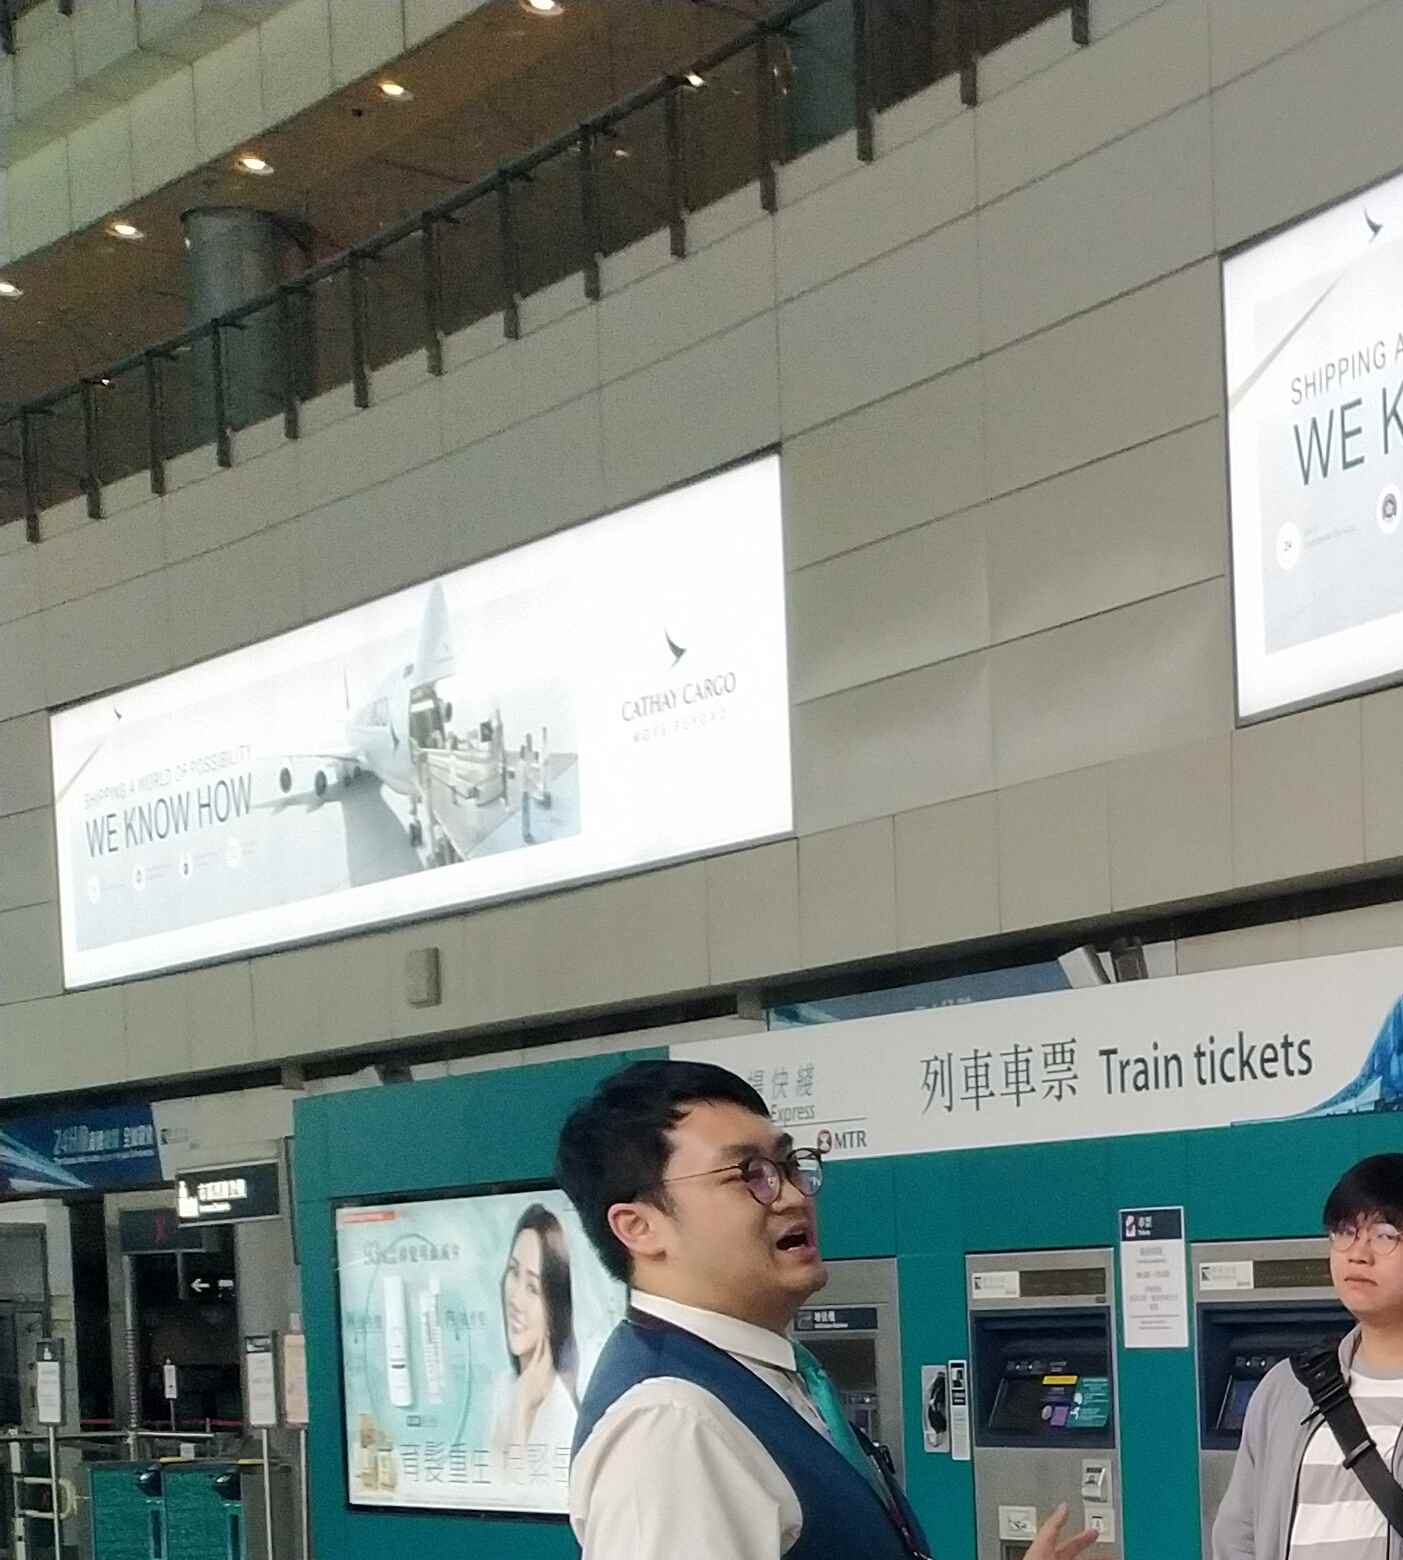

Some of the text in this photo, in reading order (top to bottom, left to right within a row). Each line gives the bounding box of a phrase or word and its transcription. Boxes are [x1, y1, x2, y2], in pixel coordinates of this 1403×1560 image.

[1290, 342, 1387, 405] SHIPPING
[1293, 397, 1366, 486] WE
[85, 772, 253, 859] WE KNOW HOW
[918, 1037, 1080, 1115] 列車車票
[1098, 1032, 1314, 1097] Train tickets
[833, 1129, 868, 1150] MTR
